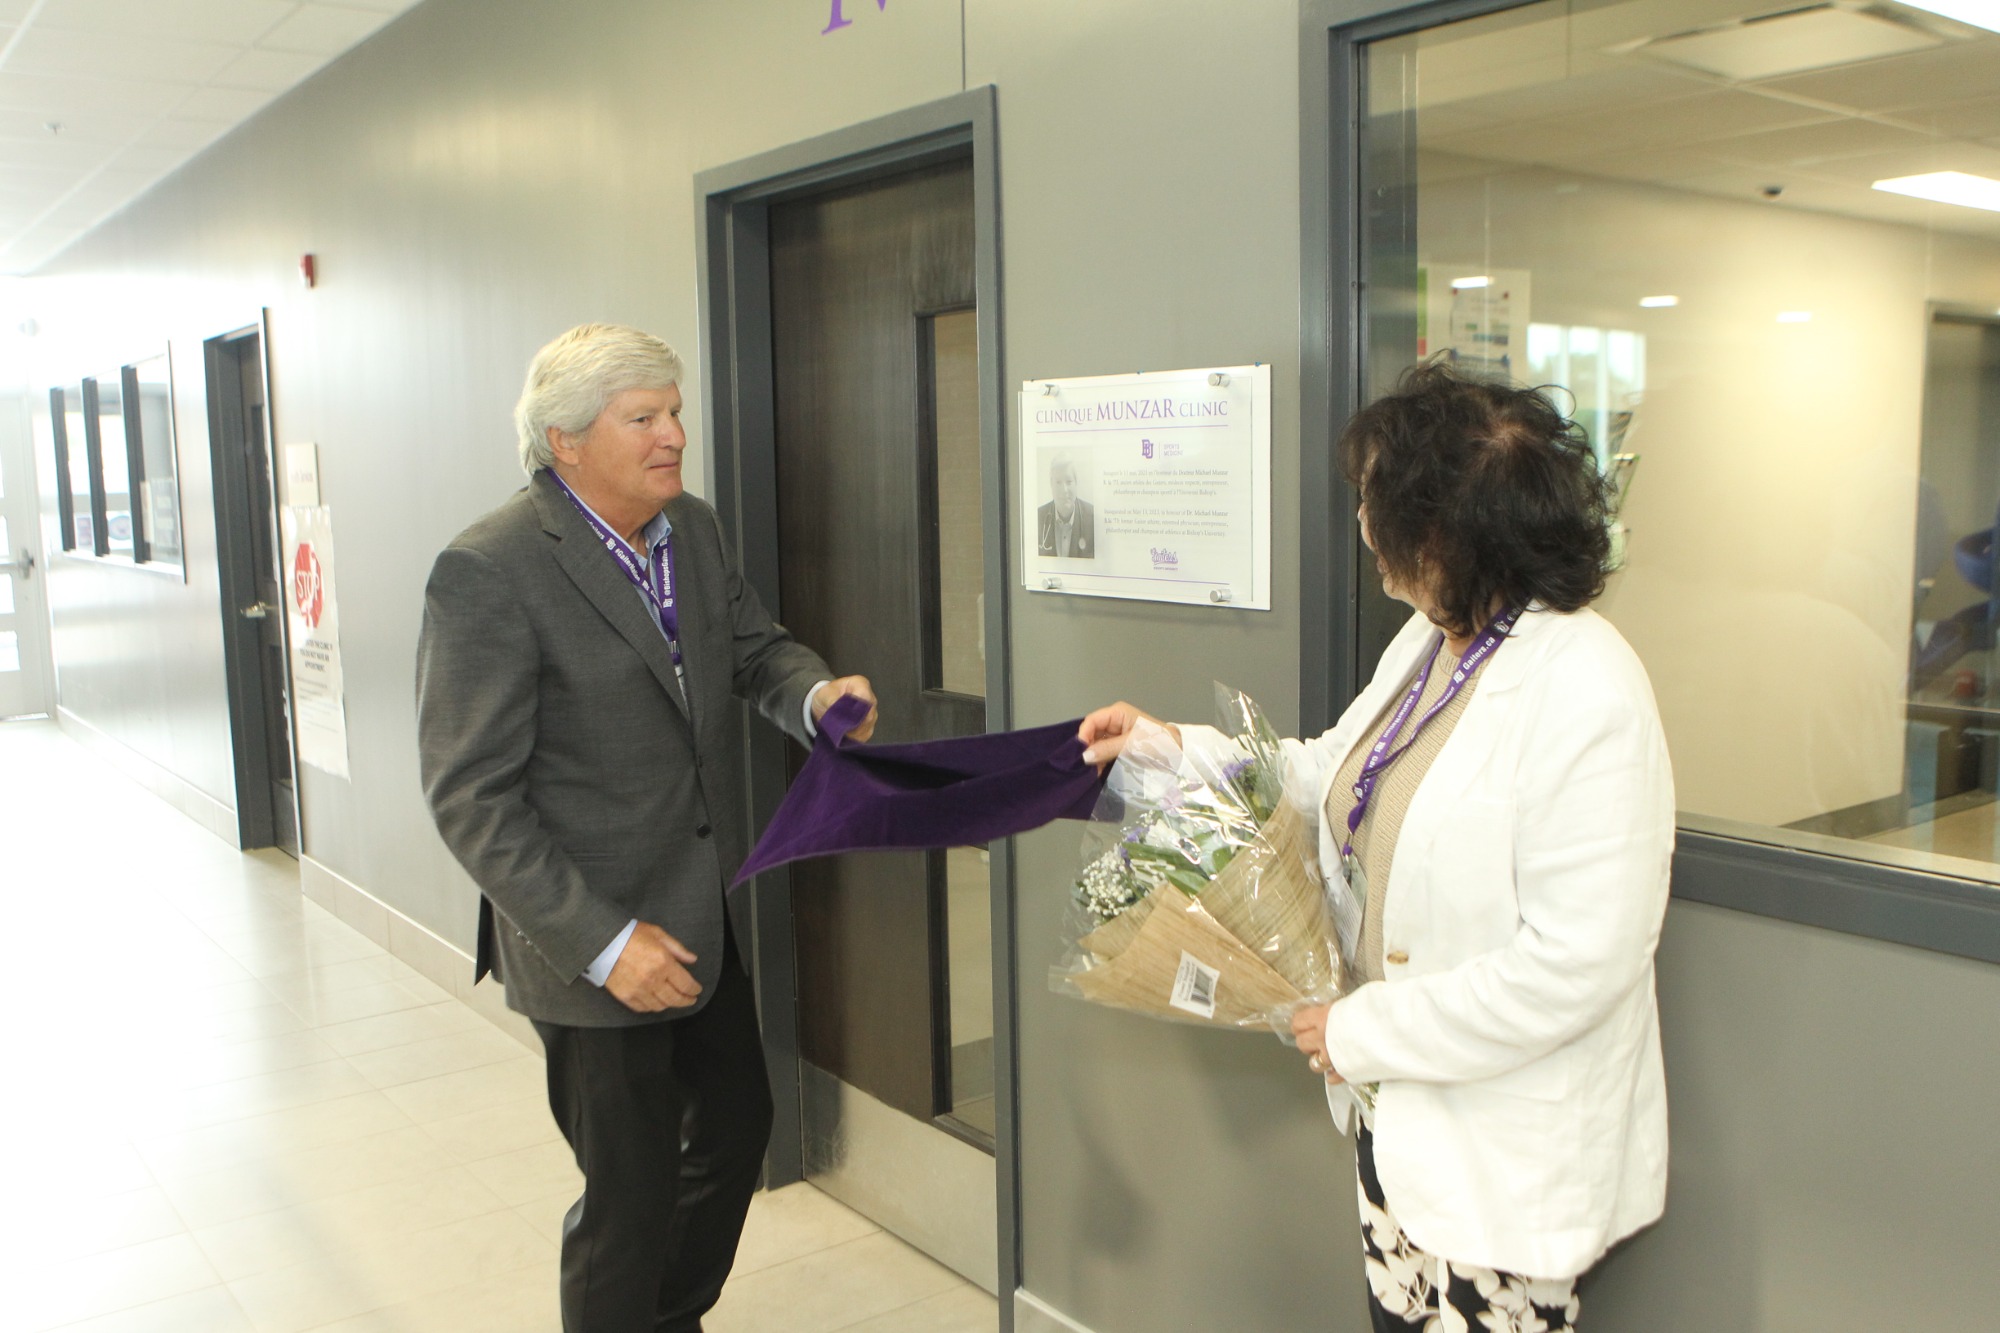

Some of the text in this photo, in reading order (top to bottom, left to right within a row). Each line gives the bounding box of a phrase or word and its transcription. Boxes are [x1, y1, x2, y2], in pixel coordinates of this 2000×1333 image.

[1036, 398, 1228, 425] CLINIQUE MUNZAR CLINIC
[295, 569, 320, 601] STOP
[1462, 636, 1496, 671] Gaiters.ca
